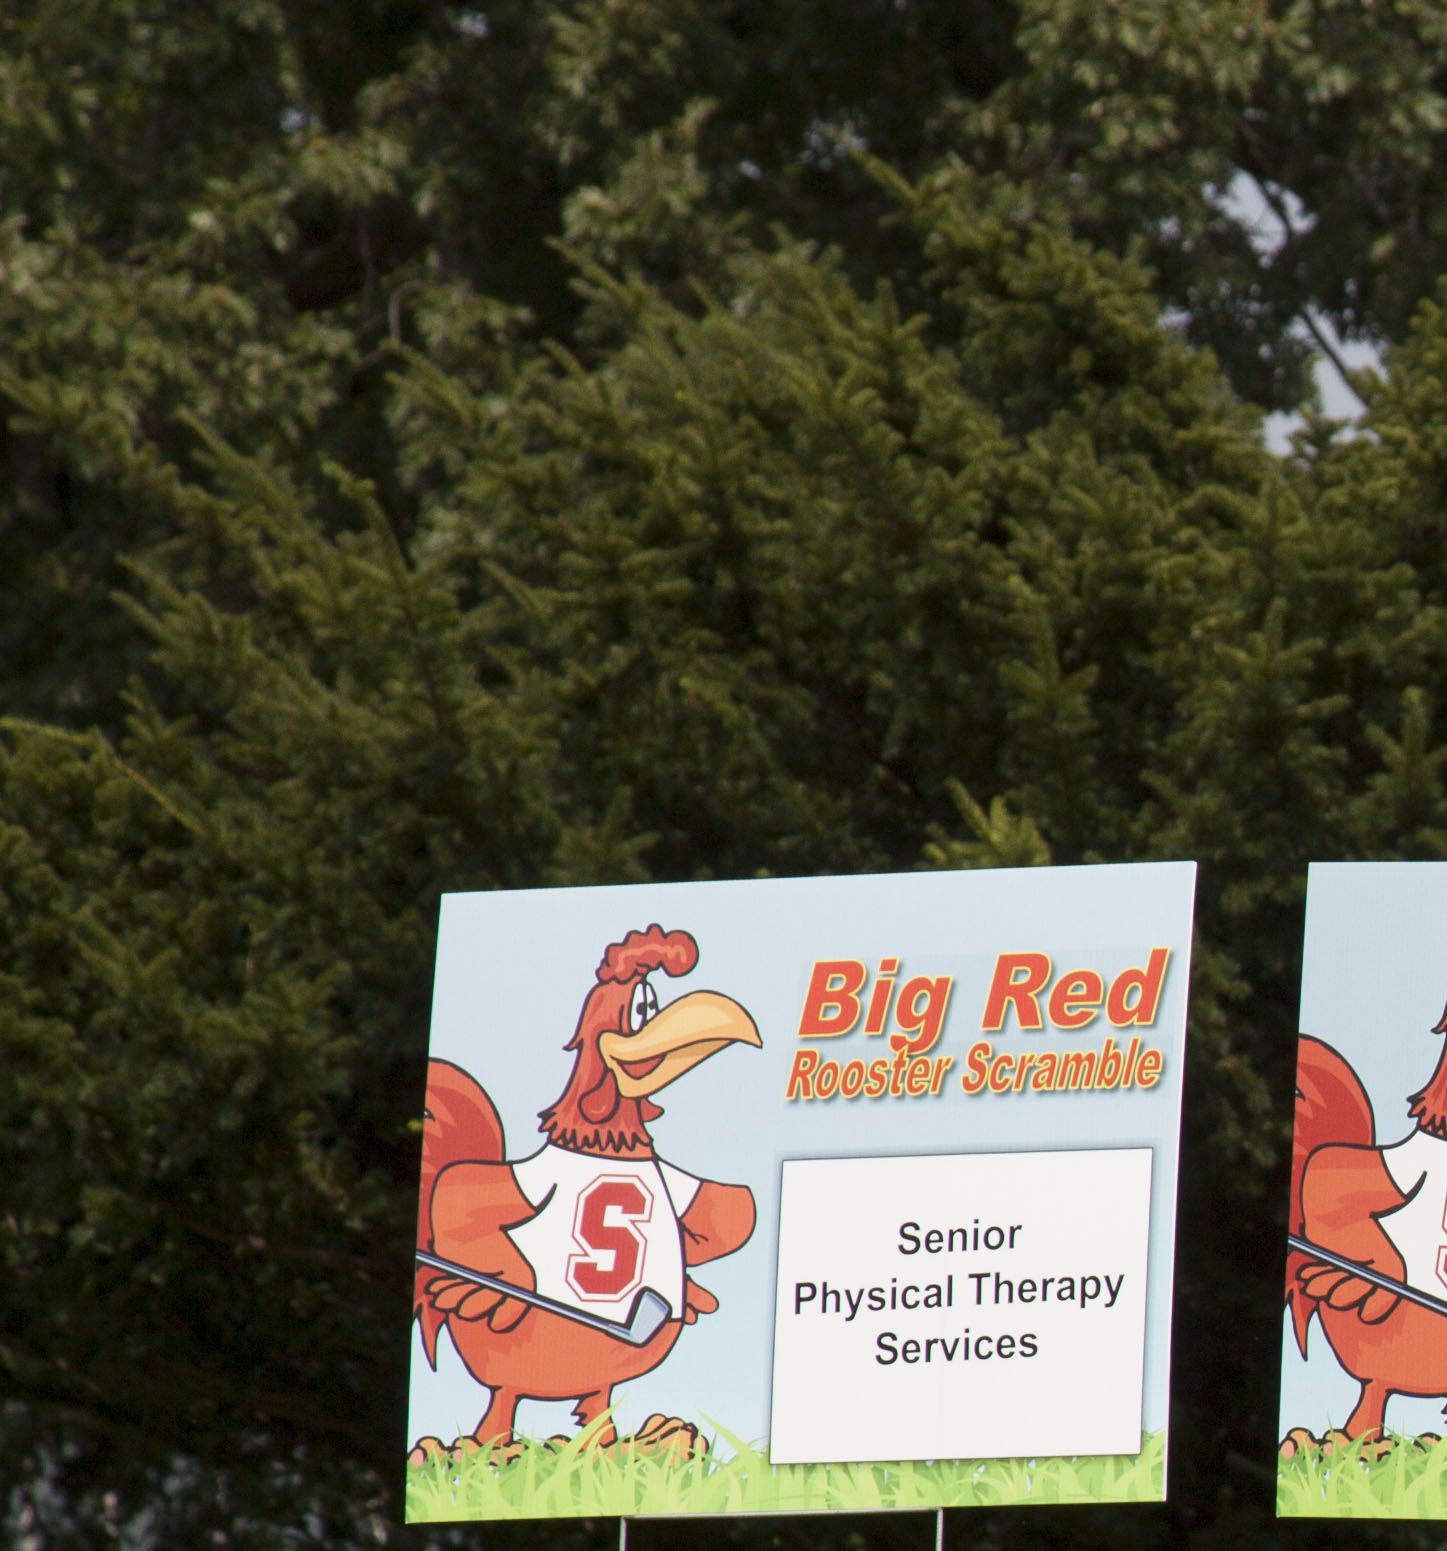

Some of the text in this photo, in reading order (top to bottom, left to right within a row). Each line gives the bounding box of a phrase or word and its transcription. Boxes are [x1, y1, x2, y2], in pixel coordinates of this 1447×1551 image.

[796, 948, 1169, 1054] Big Red
[787, 1037, 1163, 1099] Rooster Scramble
[566, 1173, 654, 1302] S
[899, 1219, 1022, 1254] Senior
[795, 1272, 1124, 1321] Physical Therapy
[876, 1330, 1037, 1365] Services
